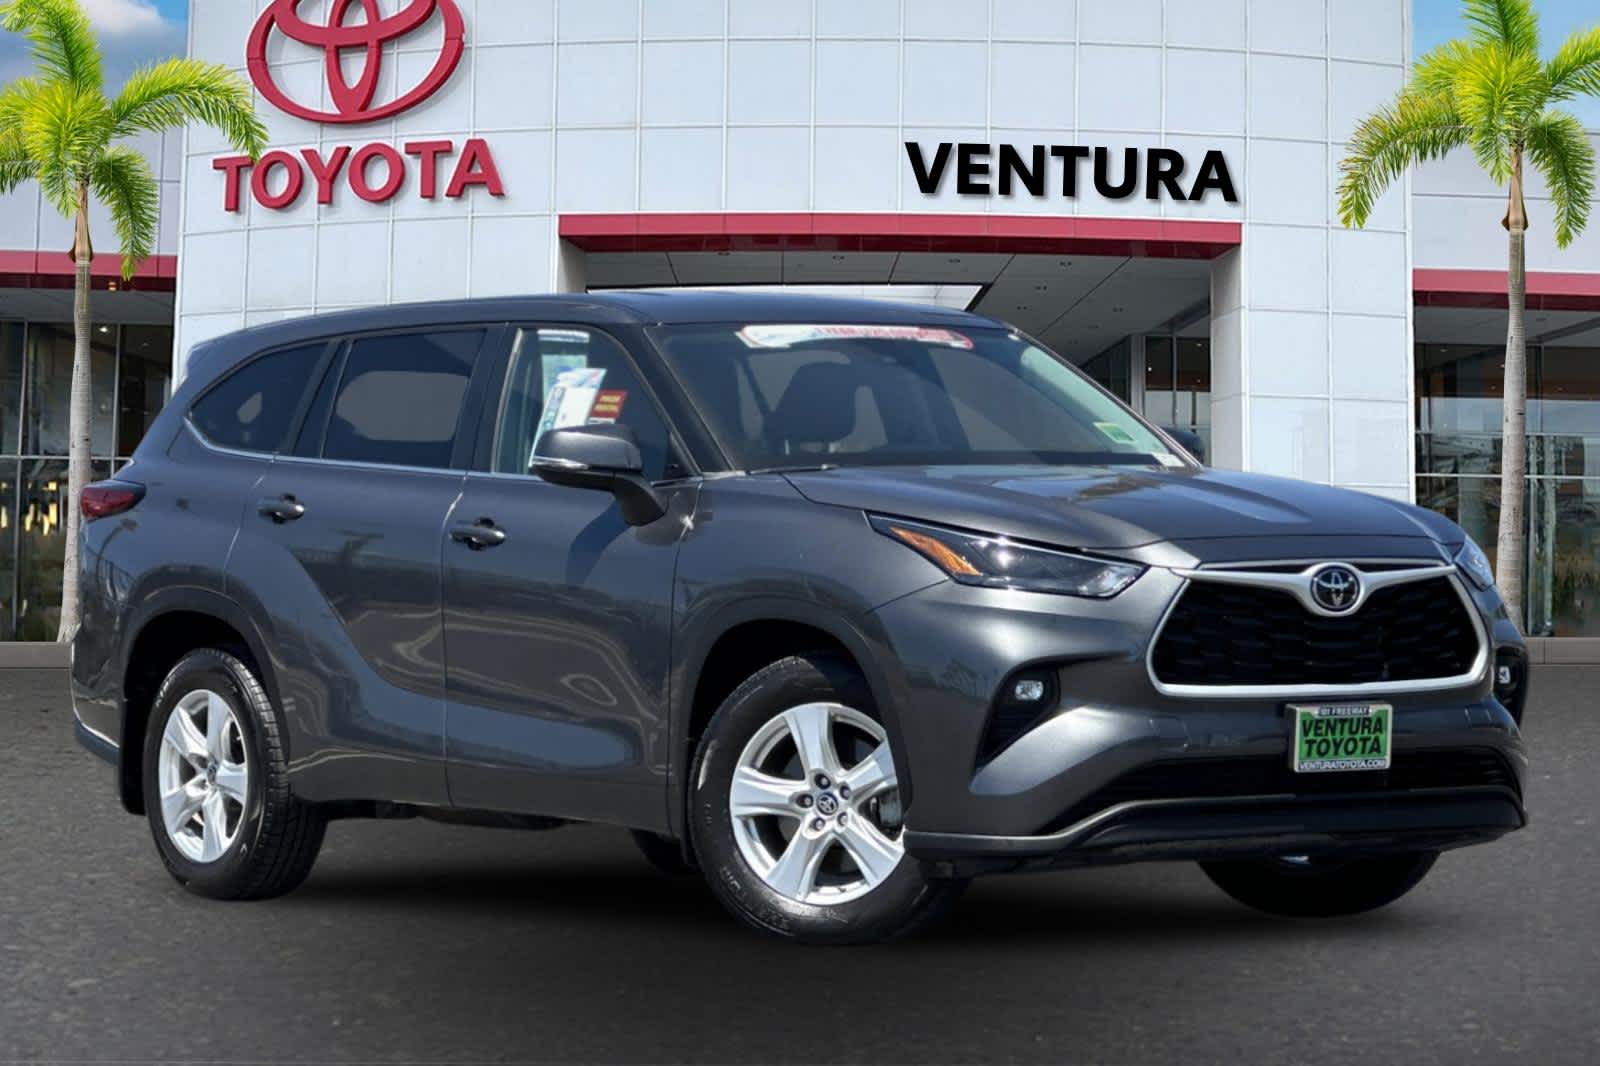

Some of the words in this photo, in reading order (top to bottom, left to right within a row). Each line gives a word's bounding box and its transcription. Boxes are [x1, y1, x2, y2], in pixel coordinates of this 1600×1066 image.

[213, 138, 504, 212] TOYOTA
[904, 141, 1238, 202] VENTURA
[1331, 706, 1368, 715] FREEWAY
[1302, 717, 1383, 737] VENTURA
[1305, 736, 1382, 757] TOYOTA
[1300, 760, 1385, 770] VENTURATOYOTA.COM
